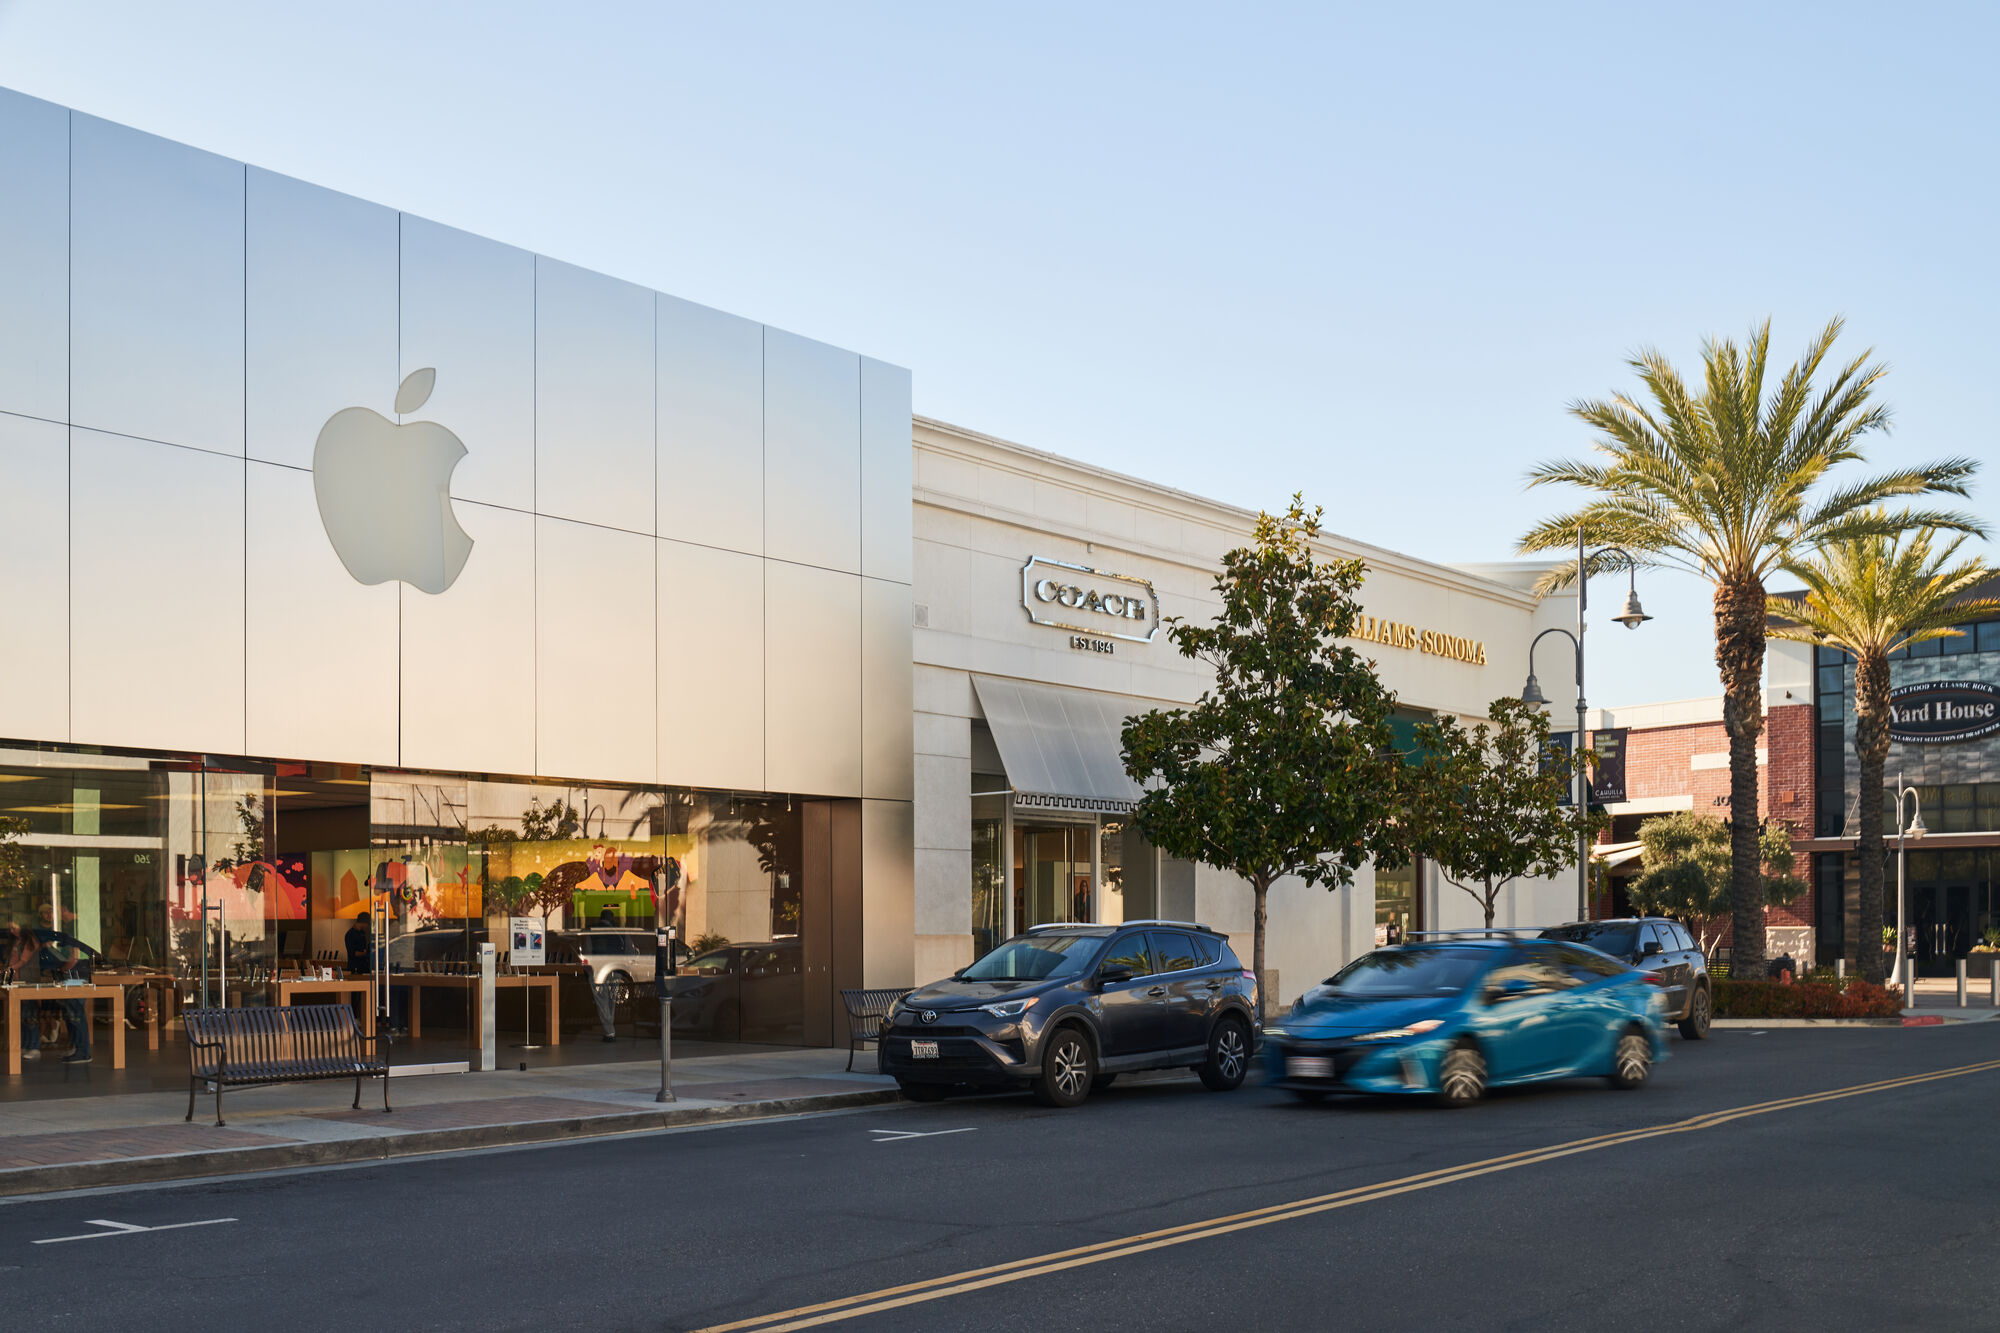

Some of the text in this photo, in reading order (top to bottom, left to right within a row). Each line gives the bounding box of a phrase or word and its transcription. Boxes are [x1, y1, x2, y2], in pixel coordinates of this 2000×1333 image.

[1035, 579, 1145, 620] COACH
[1093, 639, 1115, 655] 1941
[1346, 612, 1489, 666] LLIAMS-SONOMA
[1909, 684, 1930, 692] FOOD
[1940, 681, 1970, 689] CLASSIC
[1972, 682, 1993, 693] ROCK
[1890, 702, 1995, 723] Yard House
